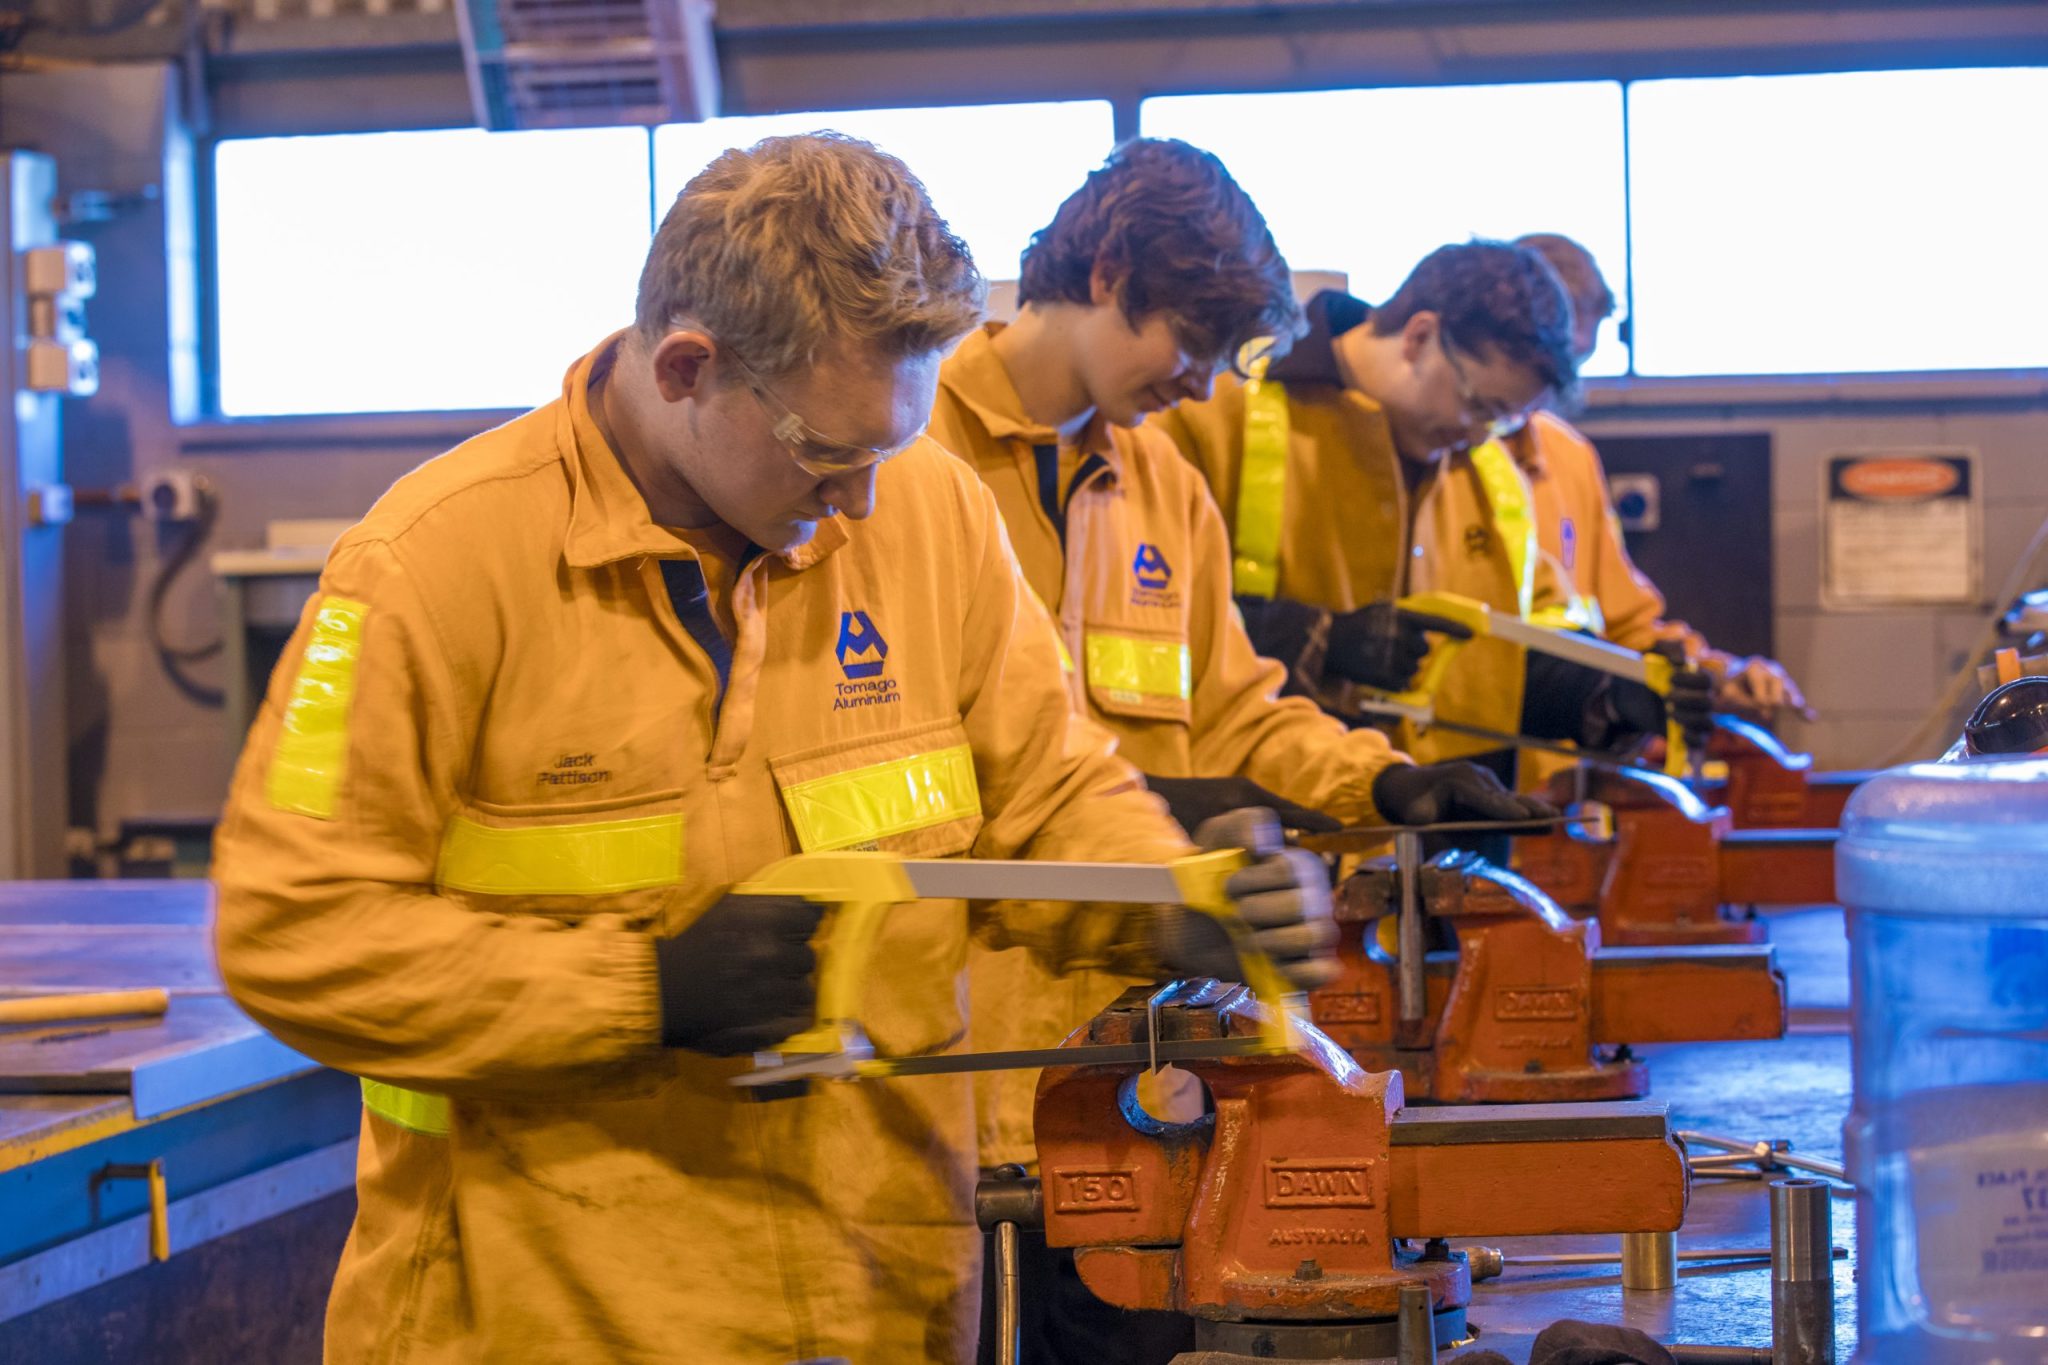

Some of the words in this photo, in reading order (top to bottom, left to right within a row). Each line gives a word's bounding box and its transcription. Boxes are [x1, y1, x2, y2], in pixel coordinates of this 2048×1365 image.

[834, 679, 897, 696] Tomago
[832, 691, 901, 712] Aluminium
[553, 752, 597, 769] Jack
[1068, 1175, 1127, 1203] 150
[1275, 1171, 1366, 1197] DAWN
[1268, 1228, 1372, 1247] AUSTRALIA
